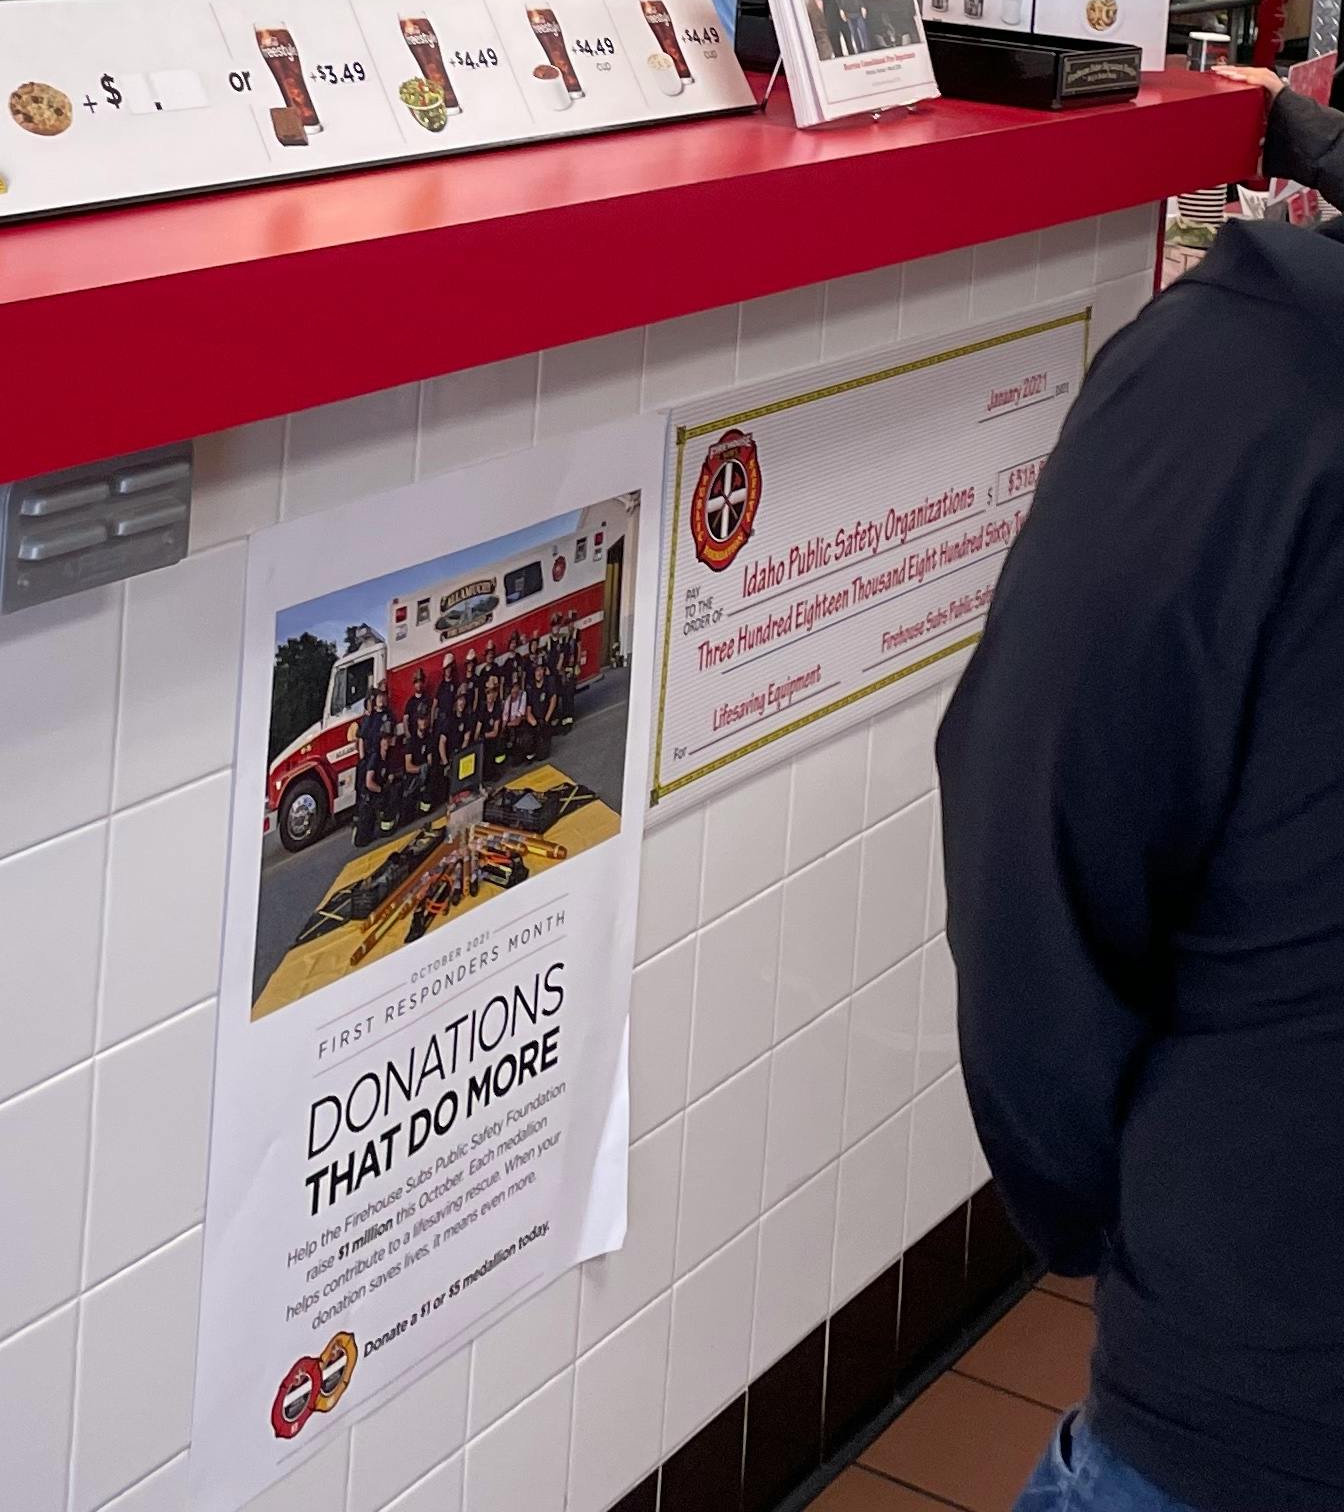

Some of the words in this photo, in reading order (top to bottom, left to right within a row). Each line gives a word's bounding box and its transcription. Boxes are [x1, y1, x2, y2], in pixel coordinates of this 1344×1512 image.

[228, 71, 252, 93] or
[987, 386, 1022, 413] January
[1022, 372, 1048, 399] 2021
[686, 586, 701, 602] PAY
[697, 640, 735, 673] Three
[737, 613, 793, 657] Hundred
[795, 580, 849, 633] Eighteen
[852, 558, 906, 602] Thousand
[907, 545, 938, 583] Eight
[939, 526, 984, 564] Hundred
[985, 516, 1013, 548] Sixty
[743, 556, 784, 599] Idaho
[789, 537, 832, 580] Public
[834, 521, 883, 560] Safety
[884, 485, 975, 545] Organizations
[683, 615, 711, 637] ORDER
[712, 607, 725, 624] OF
[685, 603, 696, 619] TO
[697, 596, 714, 613] THE
[673, 745, 688, 761] For
[712, 692, 765, 732] Lifesaving
[767, 664, 821, 712] Equipment
[318, 1015, 375, 1060] FIRST
[384, 945, 500, 1025] RESPONDERS
[508, 910, 566, 954] MONTH
[410, 946, 463, 985] OCTOBER
[466, 930, 491, 953] 2021
[305, 1123, 402, 1216] THAT
[408, 1089, 458, 1158] DO
[466, 1025, 561, 1119] MORE
[308, 962, 566, 1161] DONATIONS
[285, 1289, 319, 1324] helps
[322, 1250, 385, 1298] contribute
[387, 1235, 401, 1256] to
[402, 1232, 411, 1247] a
[412, 1195, 464, 1240] lifesaving
[504, 1146, 535, 1177] When
[537, 1131, 562, 1160] your
[287, 1240, 318, 1269] Help
[321, 1223, 343, 1248] the
[344, 1186, 403, 1232] Firehouse
[405, 1165, 433, 1196] Subs
[434, 1142, 468, 1175] Public
[470, 1121, 504, 1152] Safety
[506, 1082, 567, 1126] Foundation
[305, 1256, 335, 1284] raise
[337, 1242, 350, 1262] $1
[350, 1218, 393, 1254] million
[395, 1201, 417, 1224] this
[469, 1150, 495, 1178] Each
[496, 1115, 548, 1160] medallion
[311, 1284, 367, 1331] donation
[368, 1260, 402, 1294] saves
[432, 1234, 442, 1251] it
[442, 1210, 479, 1244] means
[480, 1191, 506, 1217] even
[507, 1171, 537, 1202] more.
[363, 1318, 409, 1359] Donate
[410, 1312, 418, 1328] a
[419, 1301, 432, 1319] $1
[432, 1293, 447, 1311] or
[448, 1280, 461, 1299] $5
[462, 1240, 517, 1289] medallion
[517, 1221, 551, 1253] today.
